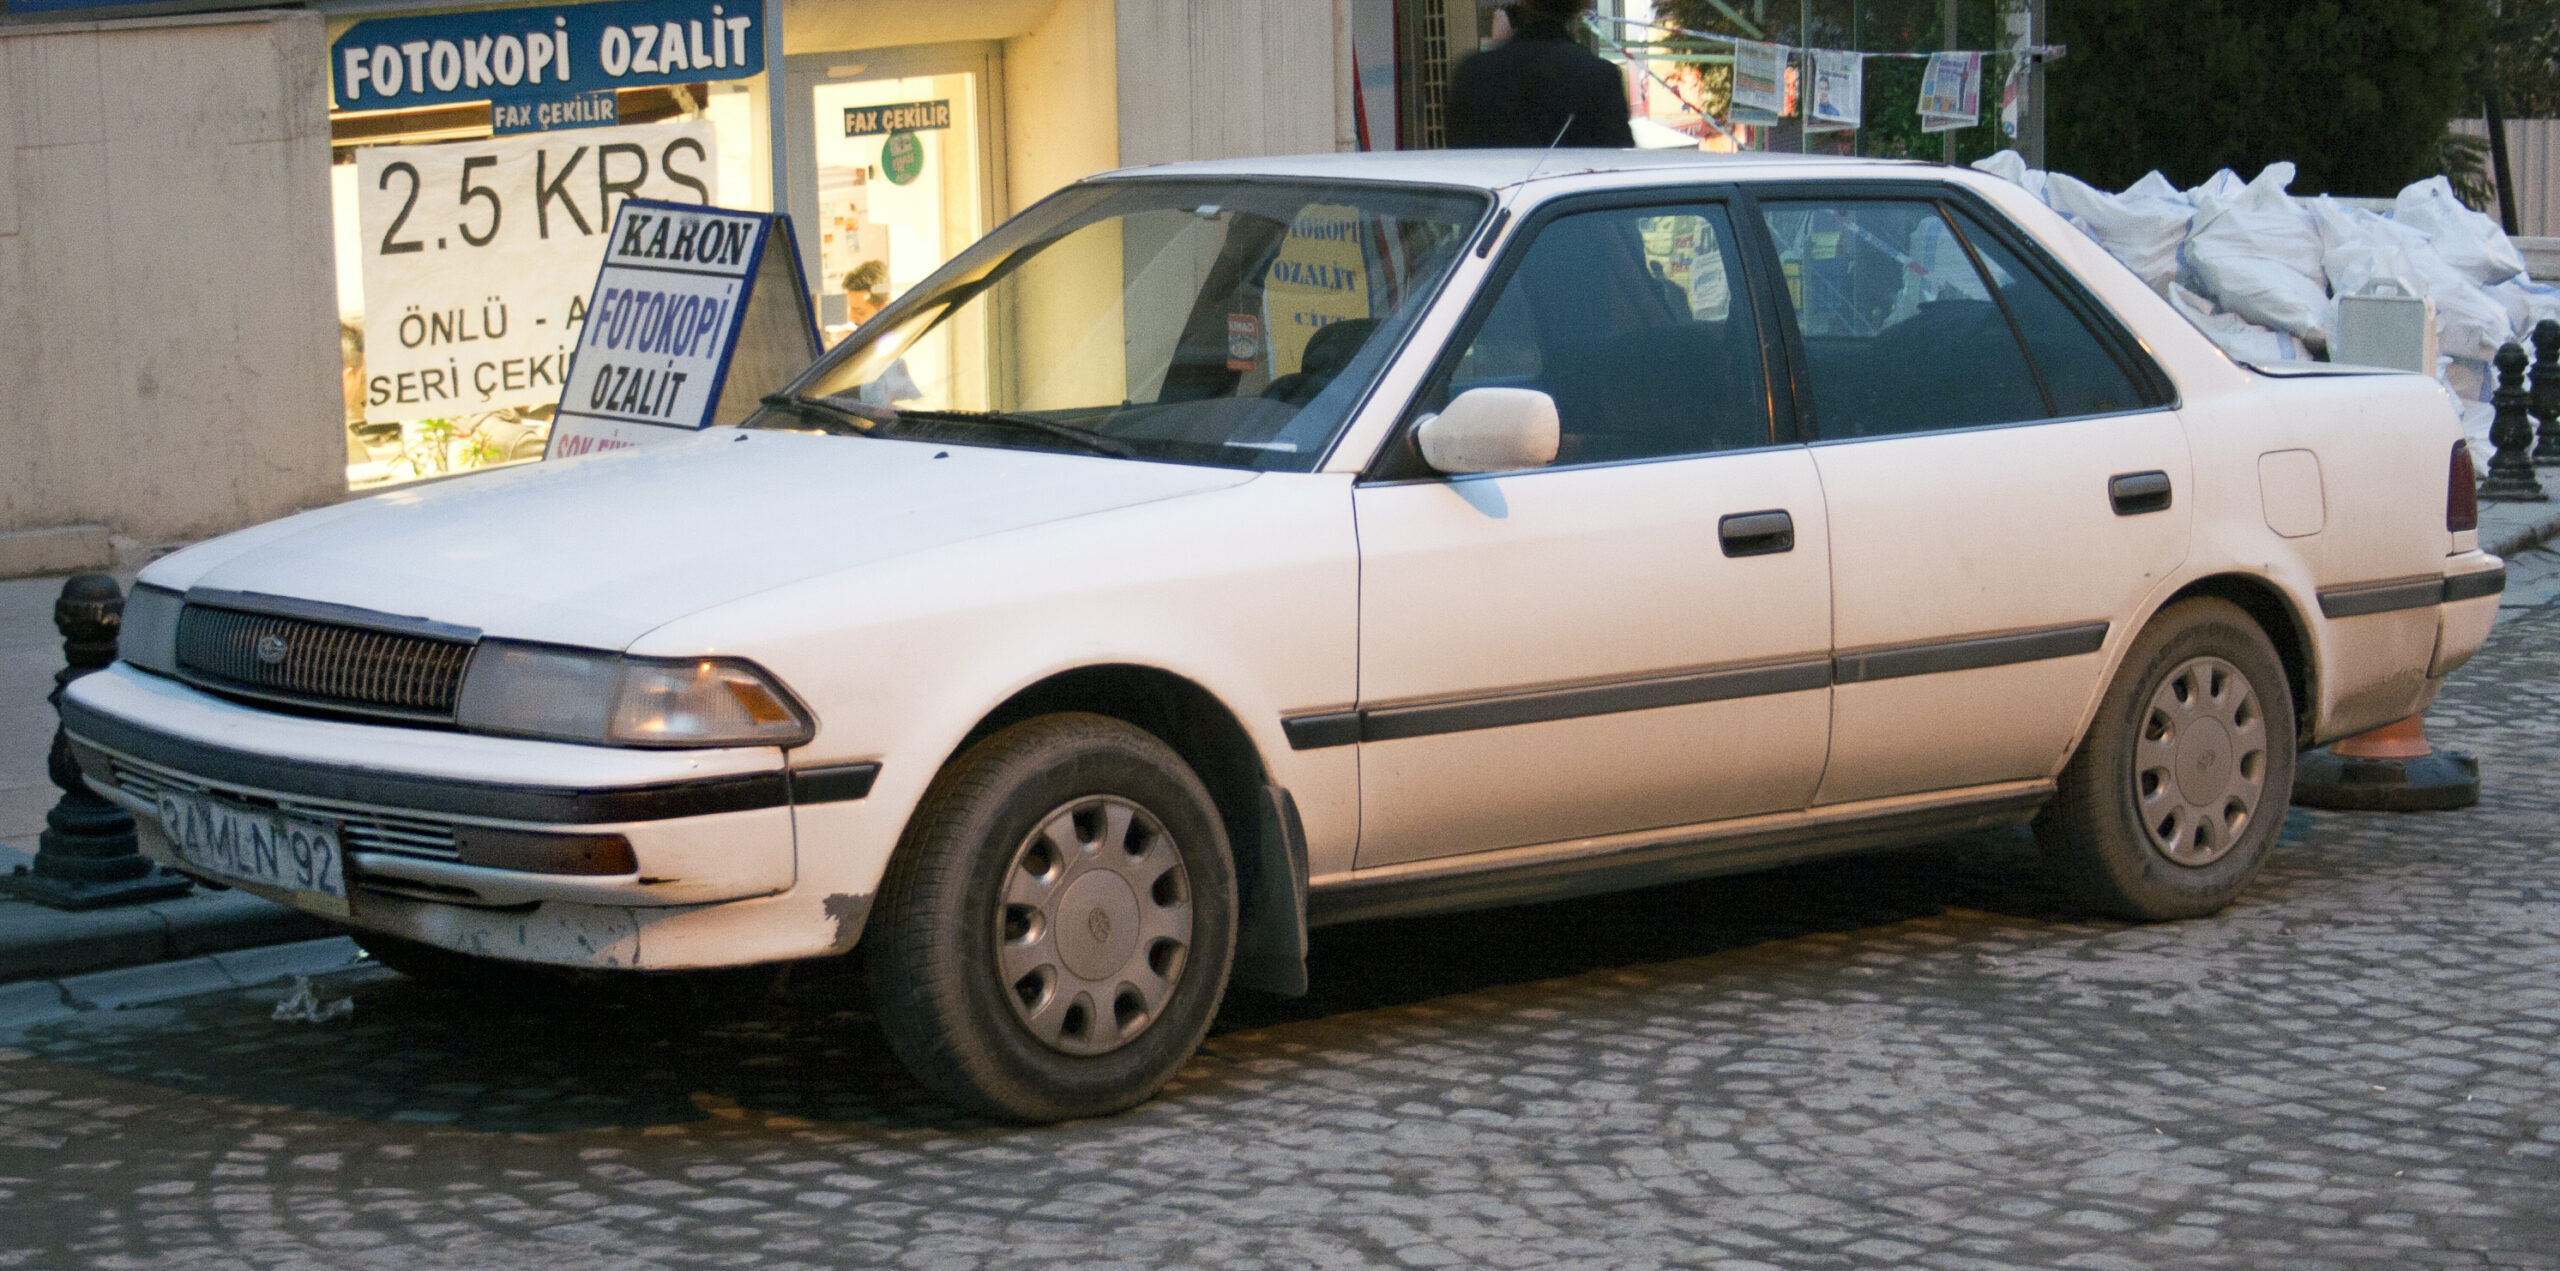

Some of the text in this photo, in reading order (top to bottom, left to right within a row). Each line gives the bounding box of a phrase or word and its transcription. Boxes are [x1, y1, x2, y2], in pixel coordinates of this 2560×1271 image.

[344, 5, 751, 100] FOTOKOPİ OZALİT
[495, 94, 614, 131] FAX ÇEKİLİR
[845, 102, 948, 134] FAX ÇEKİLİR
[379, 137, 710, 255] 2.5 KRS
[618, 213, 752, 265] KARON
[400, 297, 508, 349] ÖNLÜ
[591, 283, 733, 359] FOTOKOPİ
[370, 344, 575, 407] SERİ ÇEKİ
[590, 360, 688, 418] OZALİT
[204, 804, 280, 879] MLN
[292, 831, 338, 897] 92
